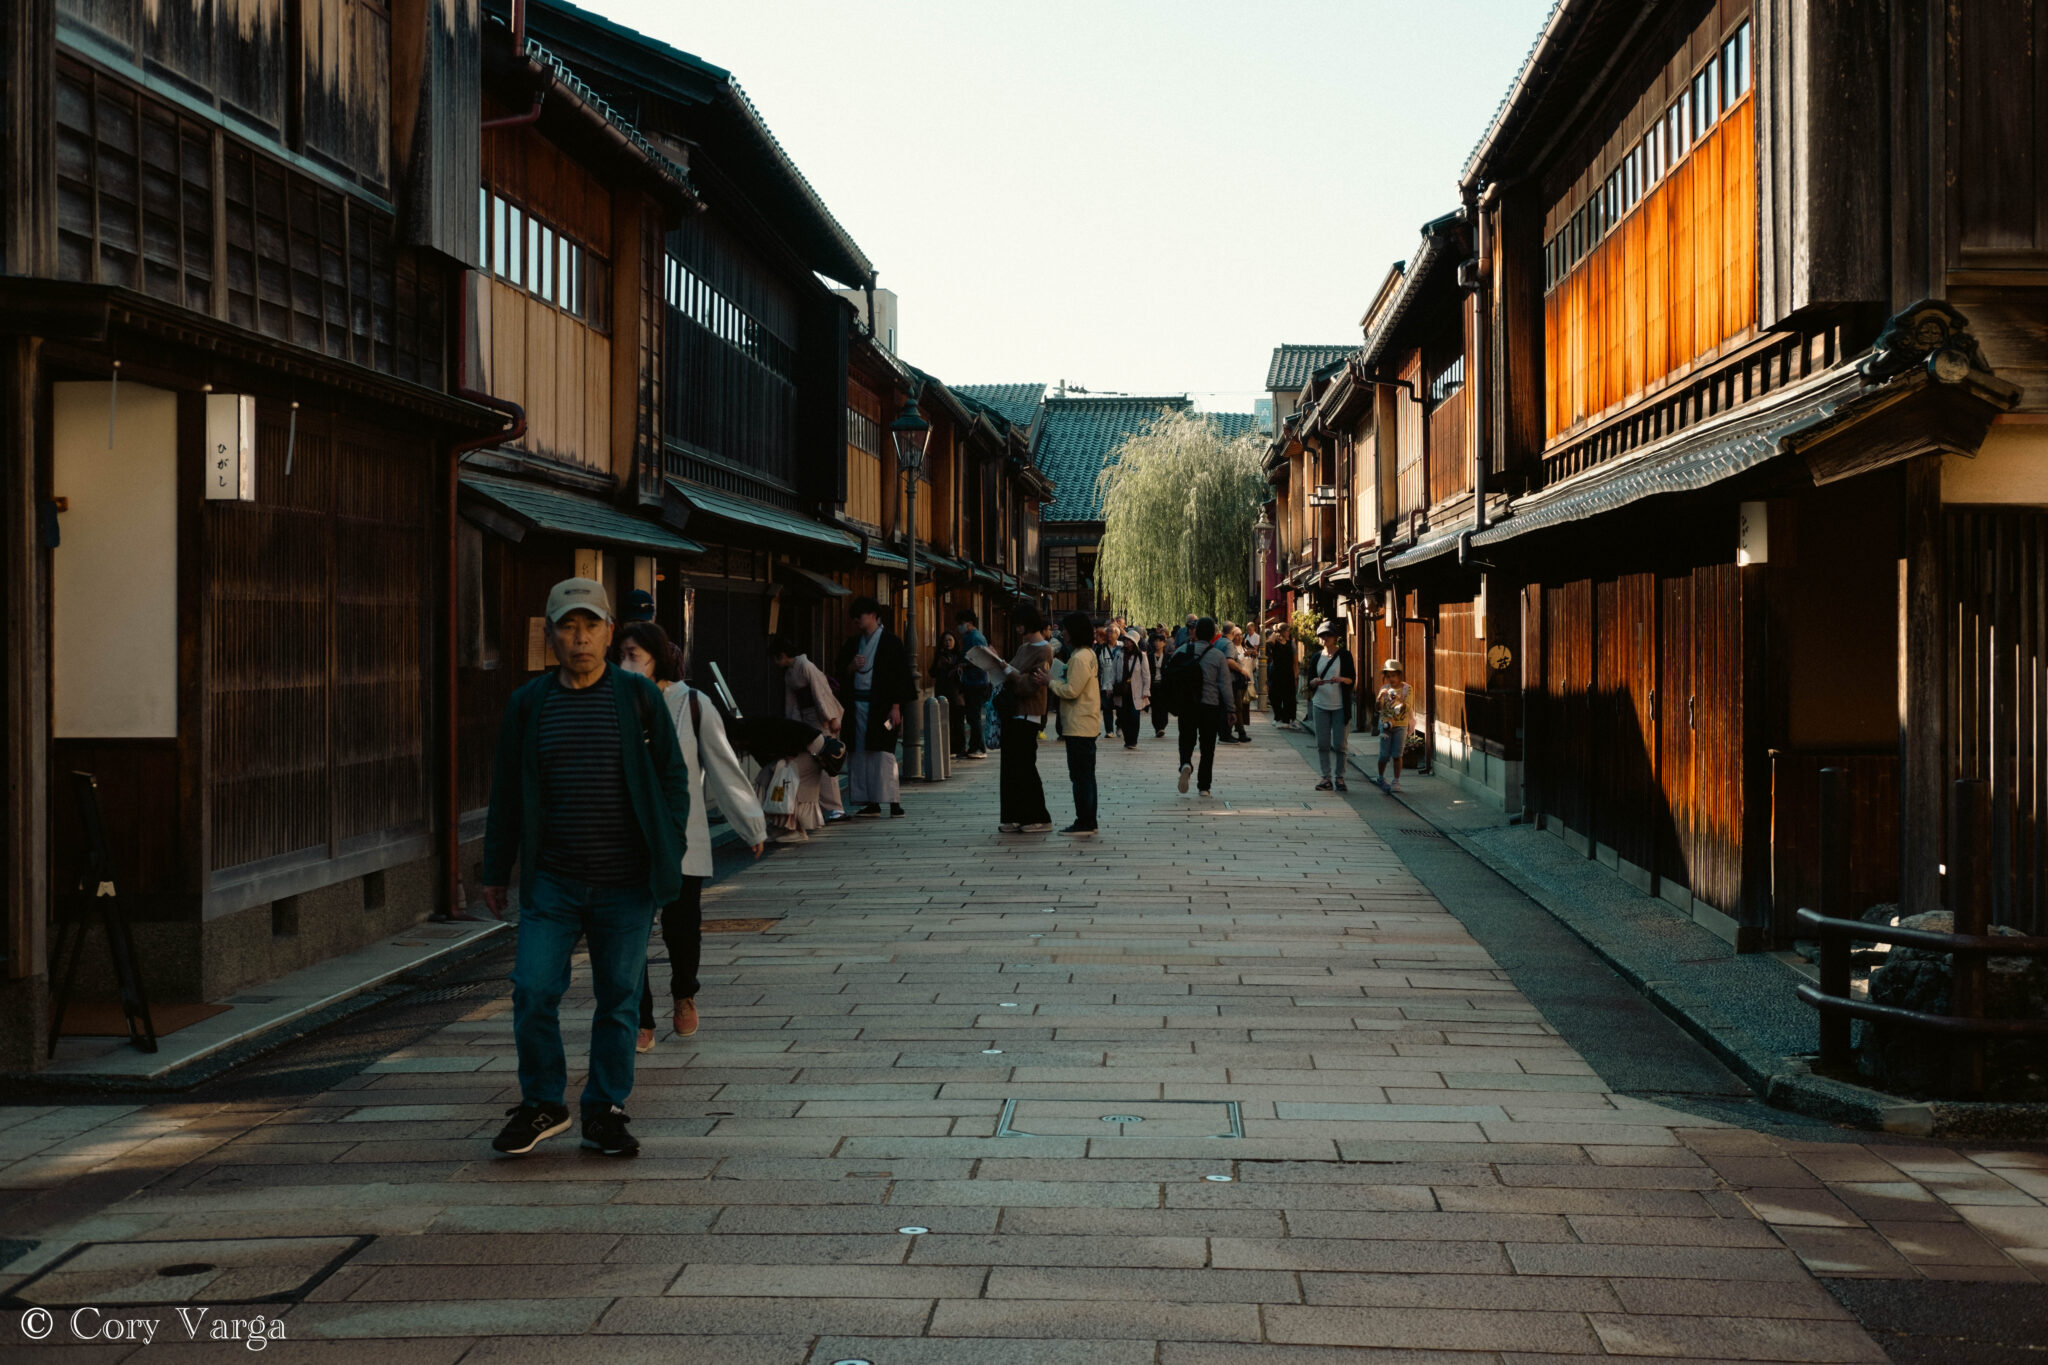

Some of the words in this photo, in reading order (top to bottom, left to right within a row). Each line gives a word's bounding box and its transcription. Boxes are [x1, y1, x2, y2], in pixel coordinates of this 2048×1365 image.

[217, 443, 229, 487] ひがし
[531, 1112, 554, 1132] N
